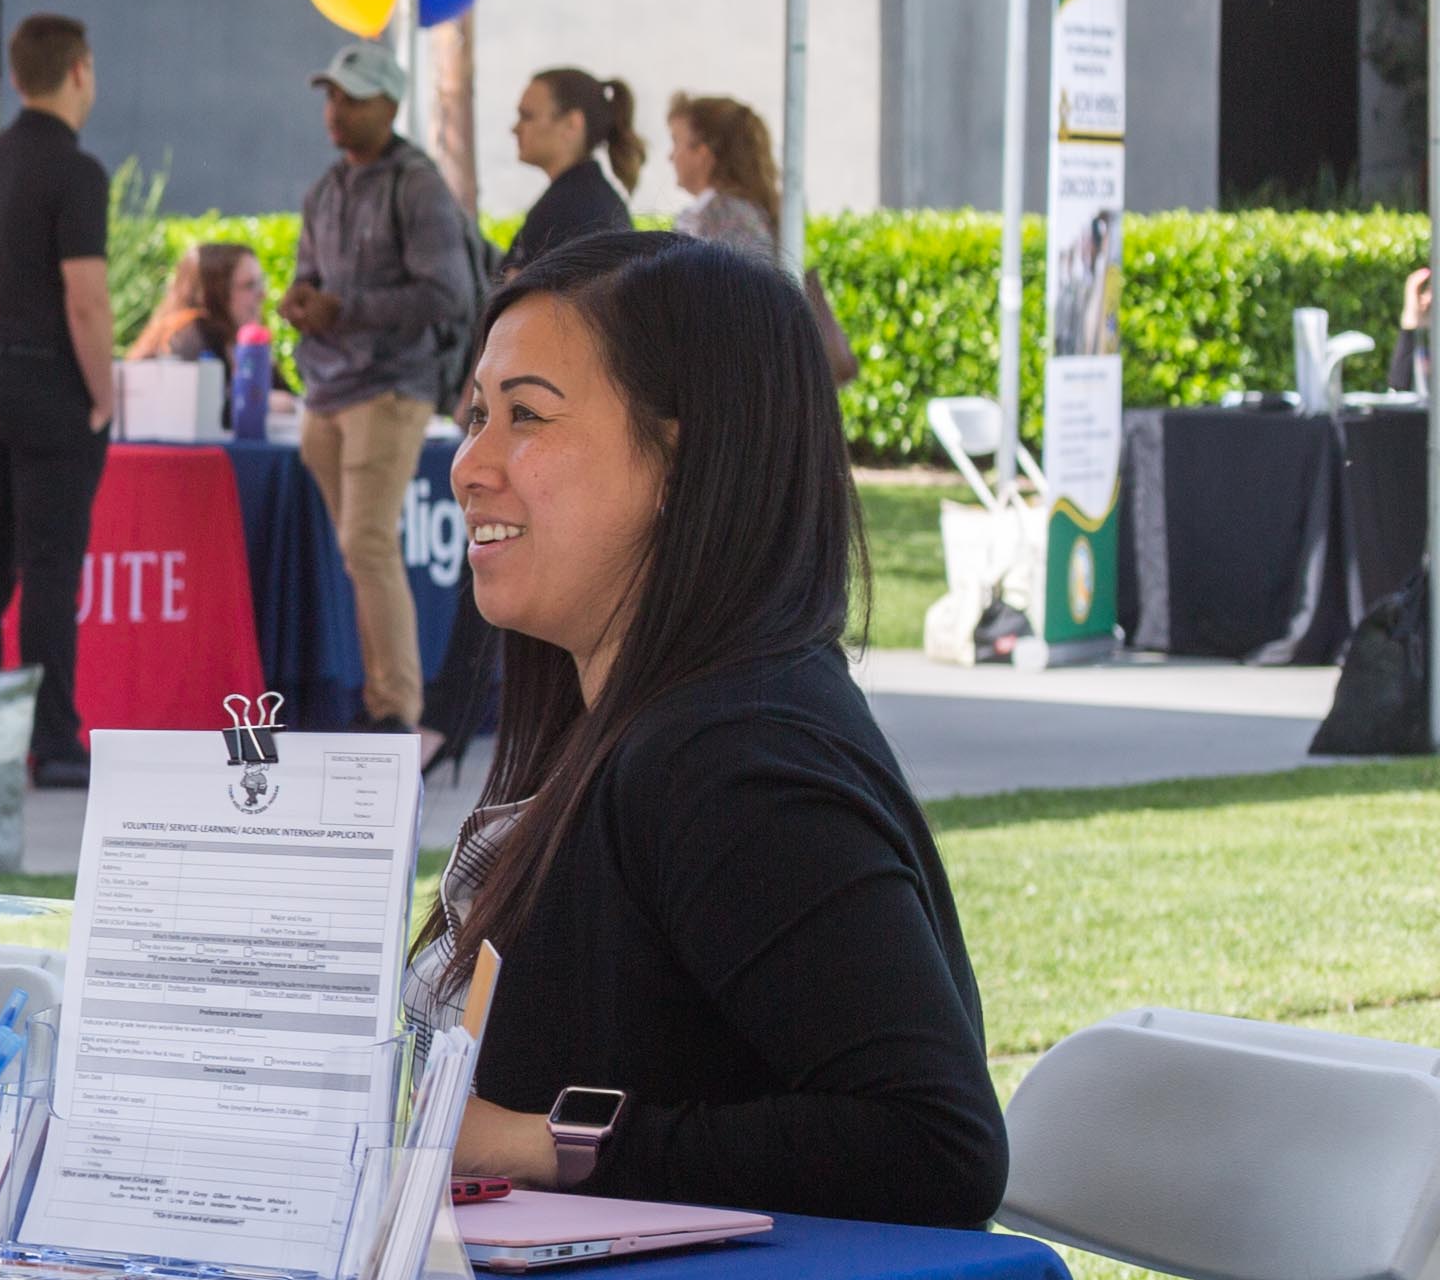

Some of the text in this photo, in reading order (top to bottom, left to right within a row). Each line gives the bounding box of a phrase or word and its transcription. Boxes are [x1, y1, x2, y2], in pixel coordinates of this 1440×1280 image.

[242, 826, 280, 836] ACADEMIC
[282, 828, 326, 838] INTERNSHIP
[327, 830, 375, 839] APPLICATION
